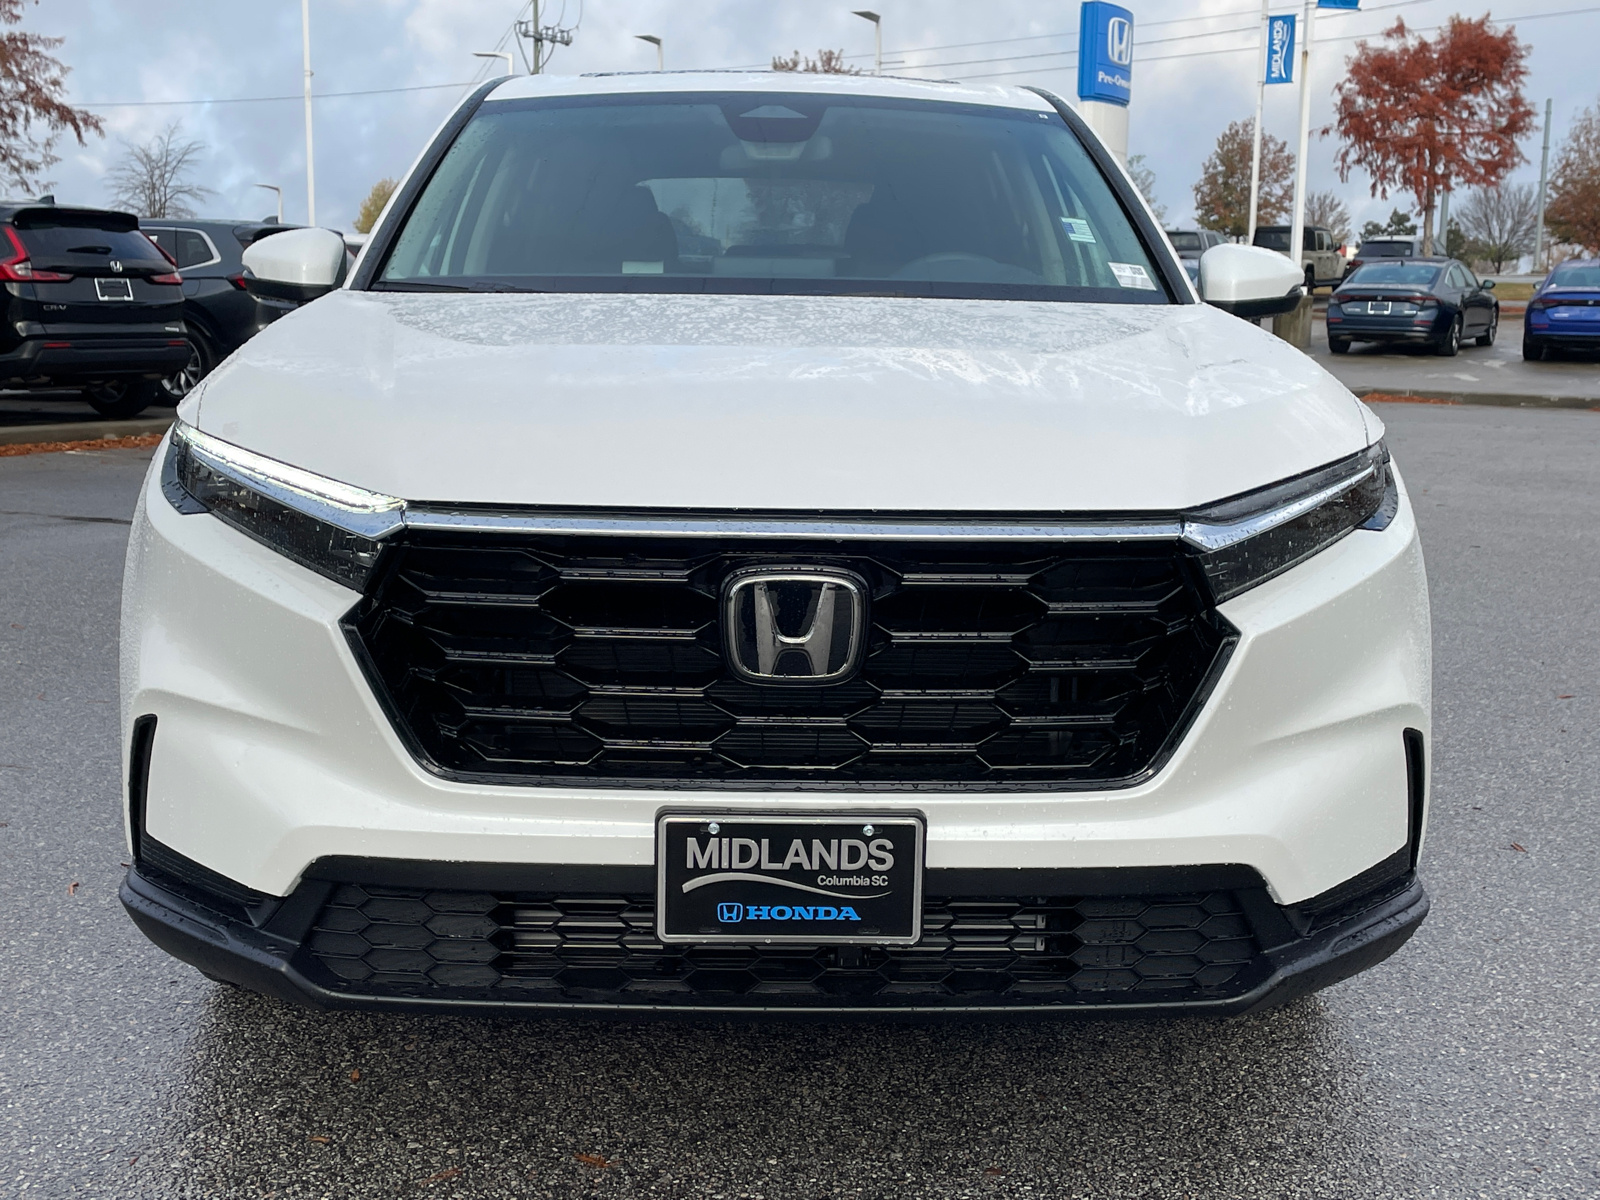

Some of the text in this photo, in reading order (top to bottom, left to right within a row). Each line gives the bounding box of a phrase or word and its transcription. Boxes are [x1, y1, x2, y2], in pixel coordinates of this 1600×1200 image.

[1271, 20, 1283, 78] MIDLANDS
[686, 837, 894, 871] MIDLANDS
[817, 875, 888, 886] Columbia SC
[746, 906, 861, 920] HONDA
